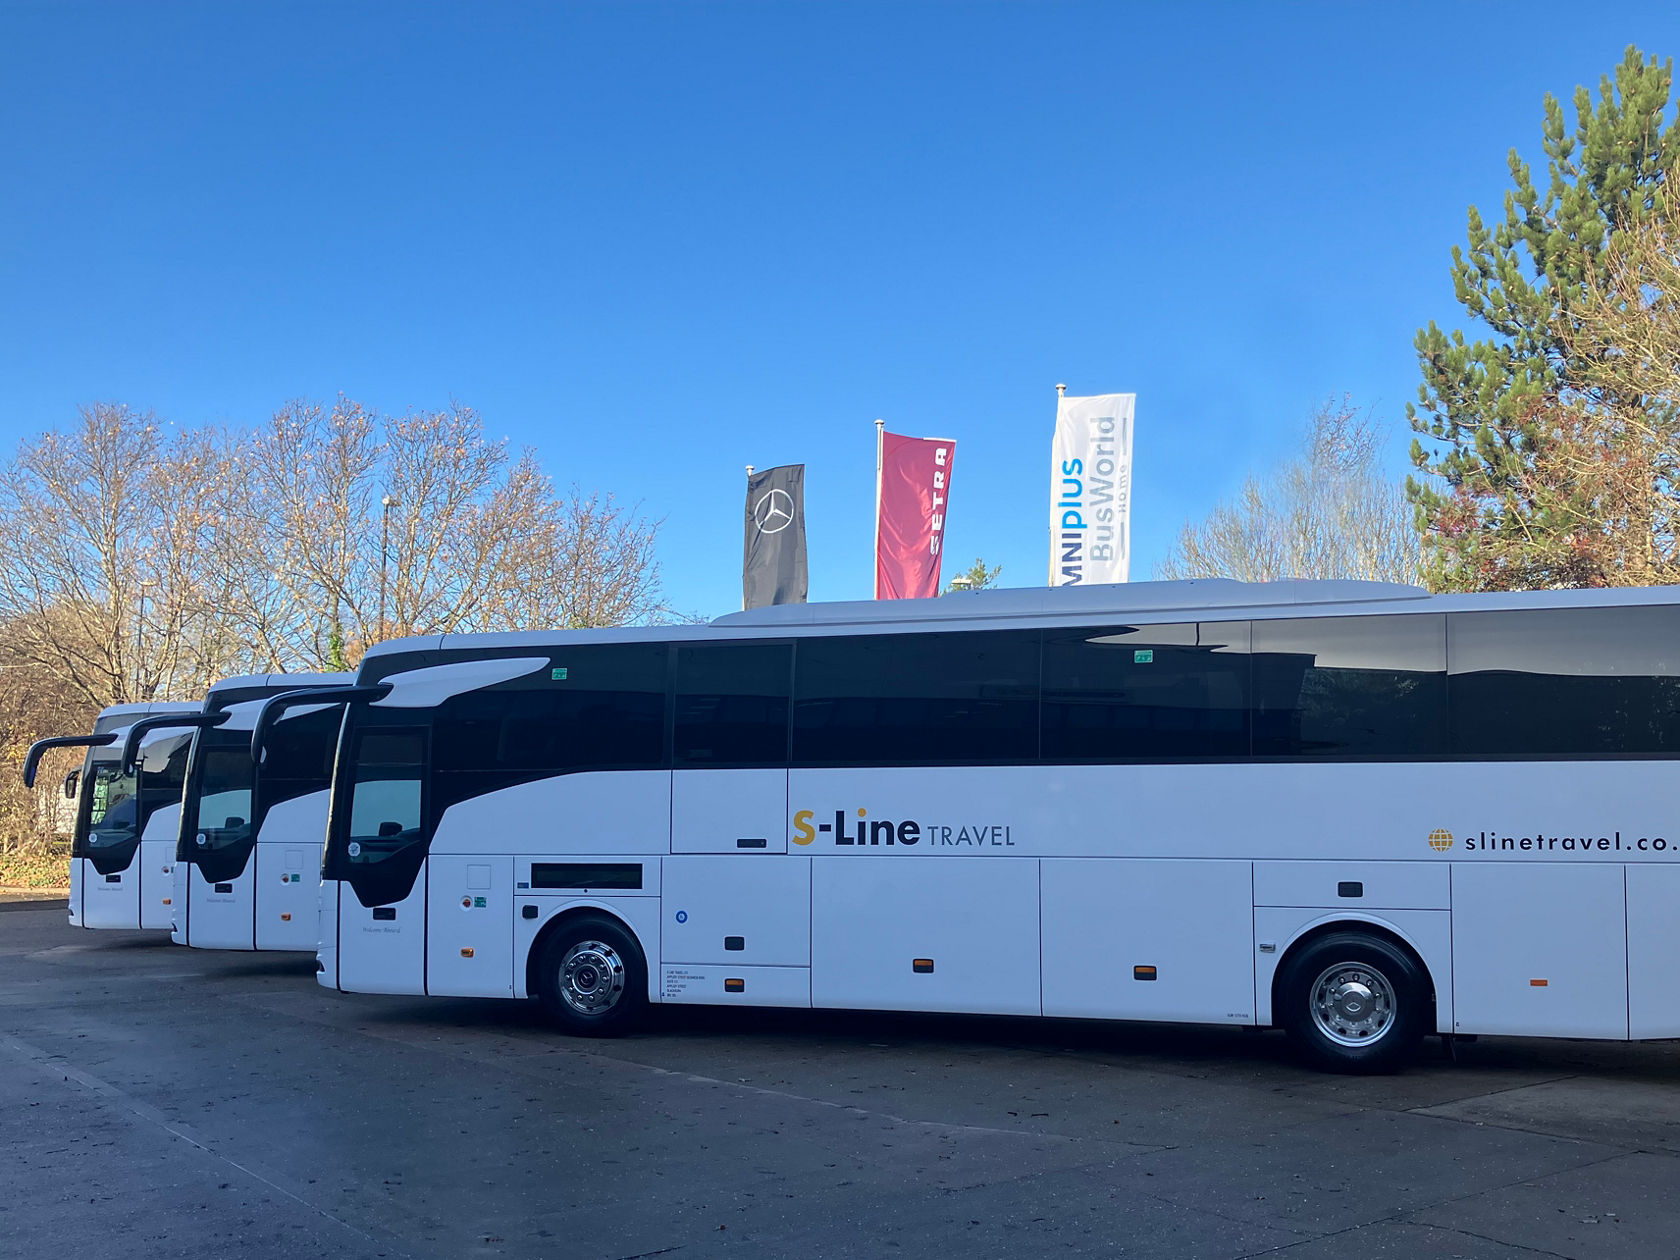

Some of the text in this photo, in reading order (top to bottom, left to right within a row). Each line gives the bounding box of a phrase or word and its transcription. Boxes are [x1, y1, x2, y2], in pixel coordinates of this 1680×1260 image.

[930, 447, 947, 556] SETRA
[1089, 416, 1116, 562] BusWorld
[792, 807, 1015, 846] S-Line TRAVEL
